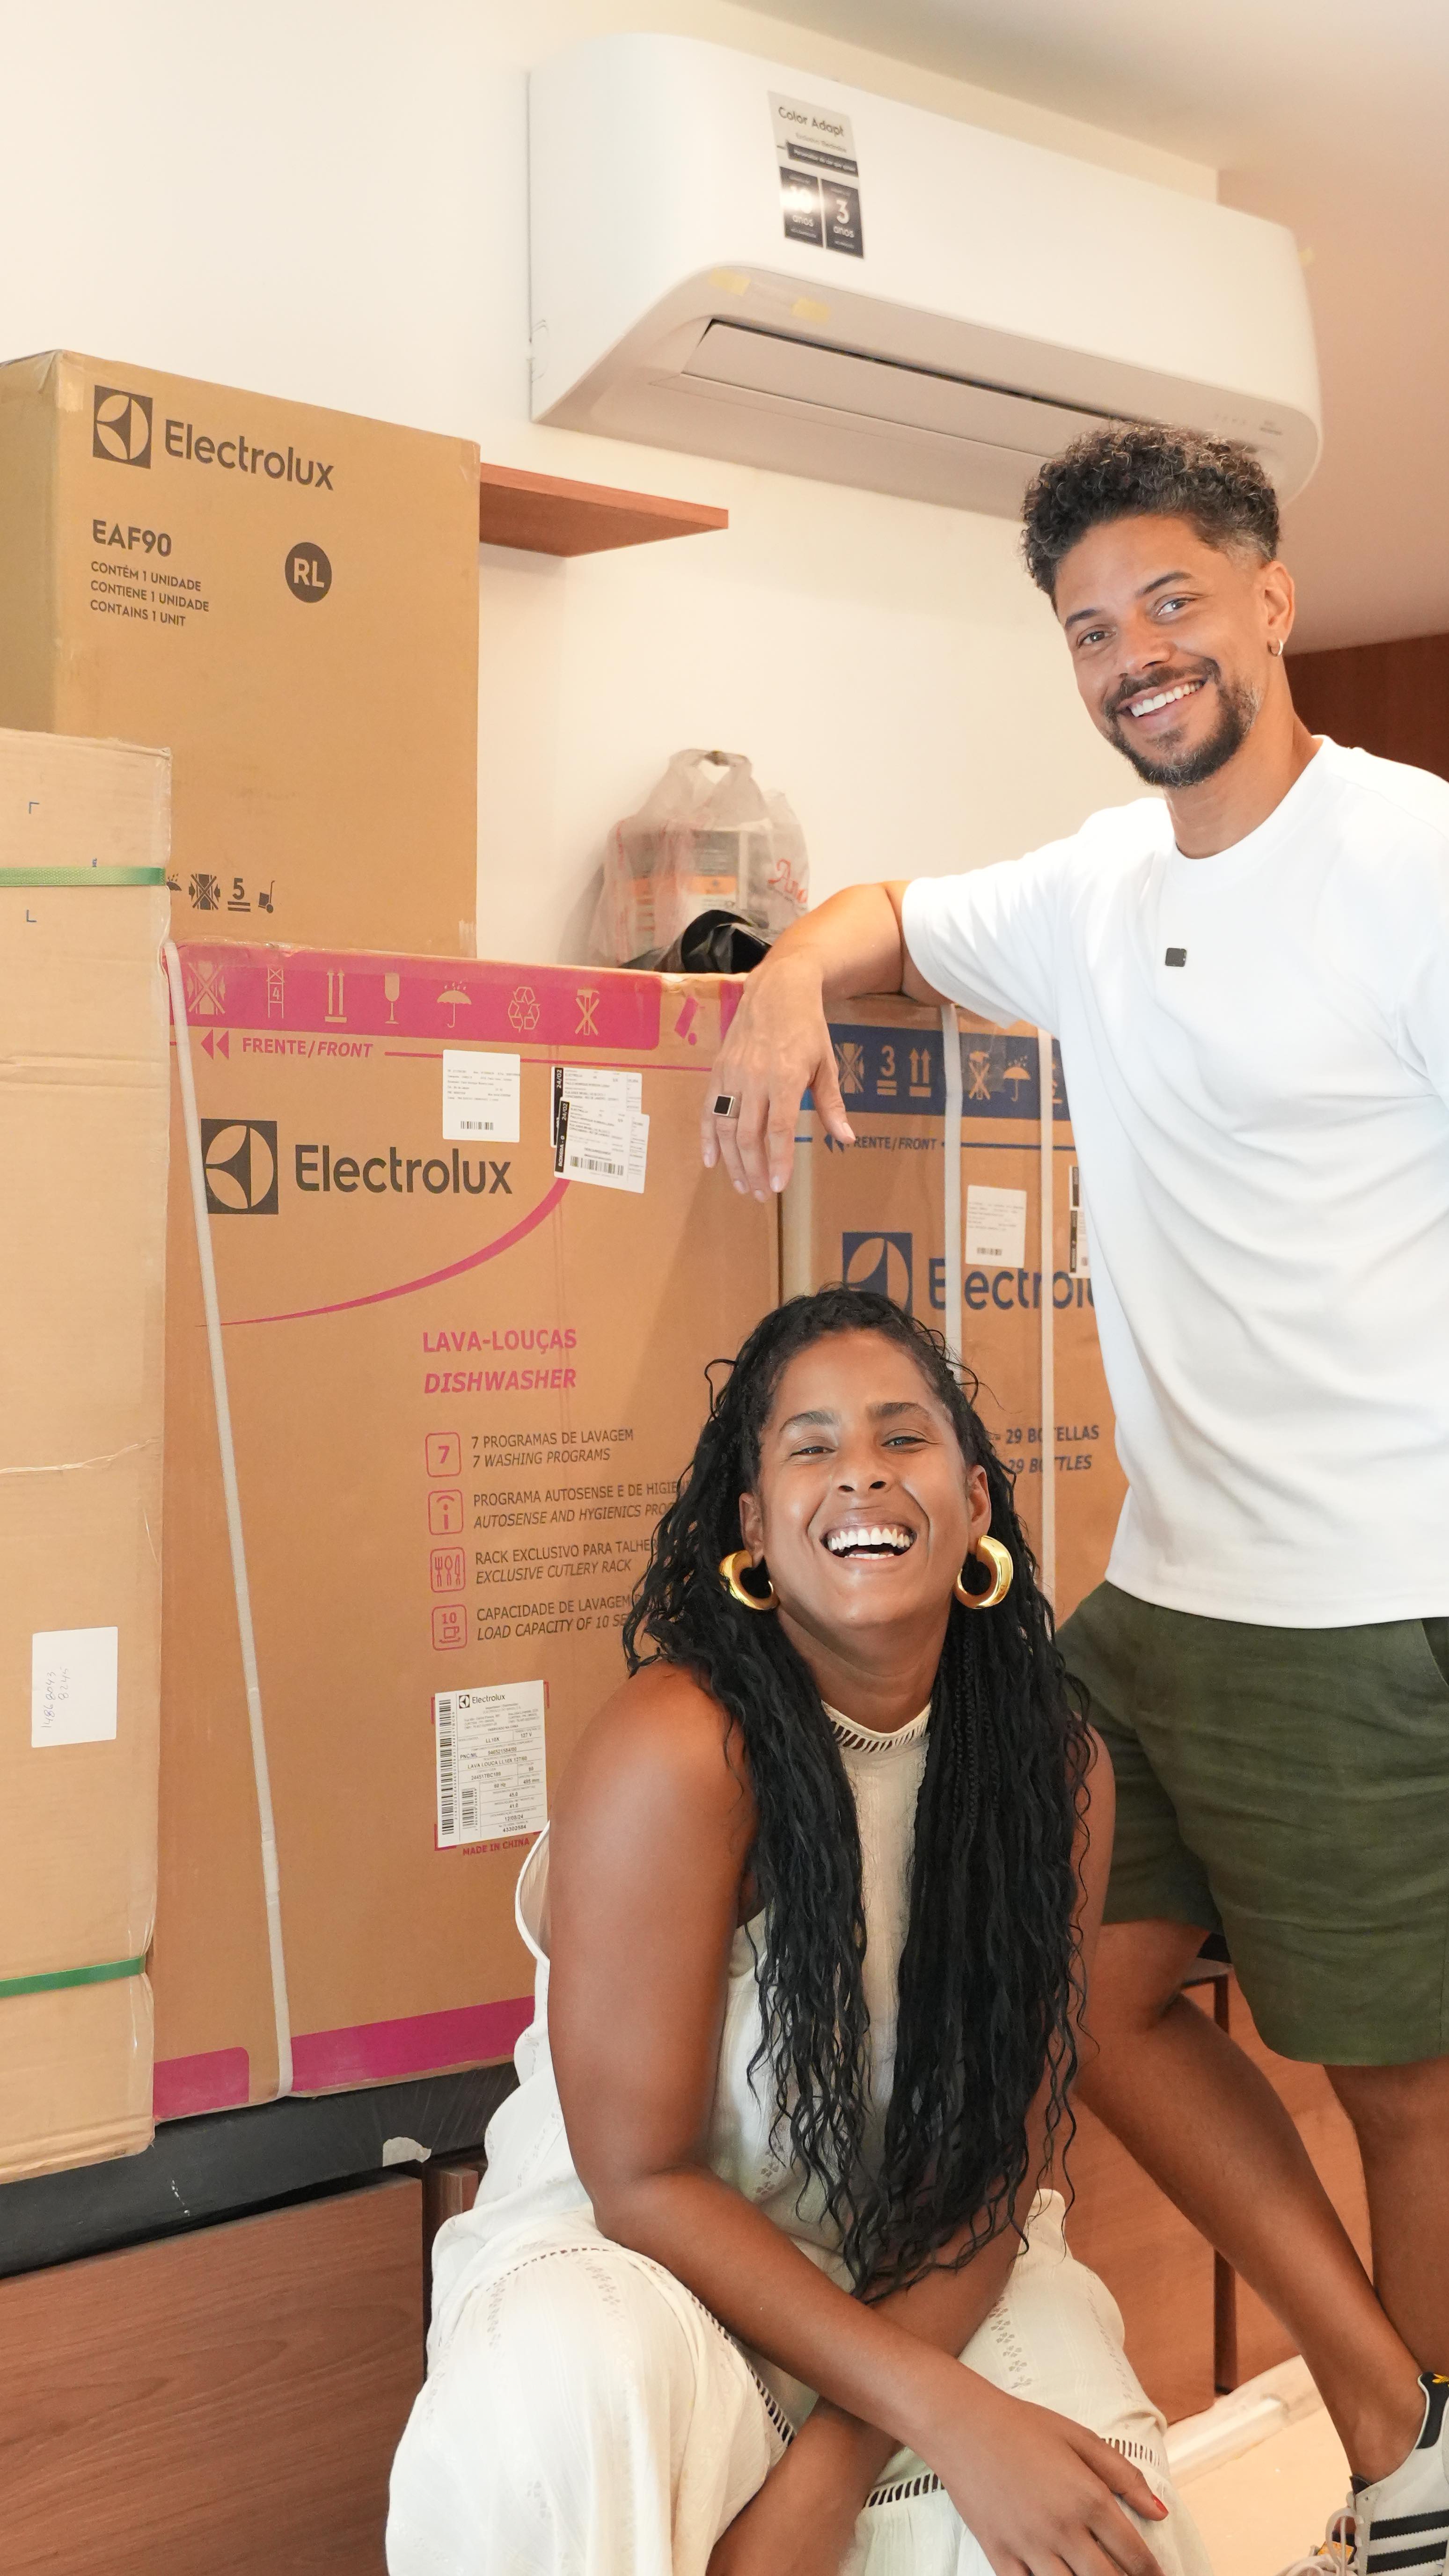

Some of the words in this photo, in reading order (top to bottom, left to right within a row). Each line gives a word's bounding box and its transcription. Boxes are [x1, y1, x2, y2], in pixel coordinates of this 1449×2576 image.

[778, 106, 808, 125] Color
[812, 118, 844, 137] Adapt
[793, 215, 814, 227] anos
[836, 199, 850, 224] 3
[833, 226, 855, 238] anos
[165, 419, 334, 491] Electrolux
[93, 520, 172, 557] EAF90
[91, 561, 139, 580] CONTÉM
[142, 571, 147, 582] 1
[151, 572, 201, 592] UNIDADE
[293, 557, 325, 588] RL
[90, 580, 147, 600] CONTIENE
[151, 591, 155, 602] 1
[159, 593, 210, 612] UNIDADE
[90, 600, 148, 620] CONTAINS
[152, 610, 156, 622] 1
[160, 612, 186, 626] UNIT
[232, 878, 245, 900] 5
[272, 987, 280, 1001] 4
[242, 1037, 374, 1058] FRENTE/FRONT
[881, 1045, 895, 1076] 3
[848, 1136, 937, 1152] RENTE/FRONT
[295, 1144, 512, 1194] Electrolux
[423, 1328, 577, 1354] LAVA-LOUÇAS
[424, 1368, 577, 1393] DISHWASHER
[471, 1436, 479, 1449] 7
[483, 1432, 557, 1449] PROGRAMAS
[562, 1431, 577, 1444] DE
[581, 1428, 634, 1443] LAVAGEM
[1006, 1427, 1022, 1444] 29
[1028, 1425, 1099, 1443] BELLAS
[438, 1445, 450, 1464] 7
[473, 1455, 480, 1468] 7
[484, 1452, 542, 1467] WASHING
[547, 1448, 611, 1464] PROGRAMS
[1029, 1455, 1092, 1473] BTLES
[474, 1490, 541, 1507] PROGRAMA
[545, 1486, 613, 1502] AUTOSENSE
[617, 1485, 624, 1497] E
[628, 1484, 642, 1496] DE
[474, 1512, 548, 1529] AUTOSENSE
[550, 1509, 574, 1523] AND
[579, 1504, 642, 1521] HYGIENICS
[476, 1550, 509, 1565] RACK
[513, 1544, 579, 1561] EXCLUSIVO
[583, 1542, 612, 1557] PARA
[476, 1566, 543, 1584] EXCLUSIVE
[547, 1561, 599, 1578] CUTLERY
[601, 1559, 632, 1573] RACK
[442, 1612, 457, 1625] 10
[477, 1602, 555, 1621] CAPACIDADE
[559, 1601, 574, 1613] DE
[578, 1595, 631, 1612] LAVAGEM
[477, 1625, 511, 1641] LOAD
[515, 1619, 574, 1637] CAPACITY
[576, 1617, 591, 1630] OF
[596, 1615, 608, 1629] 10
[472, 1694, 505, 1704] Electrolux
[463, 1845, 488, 1856] MADE
[503, 1838, 529, 1849] CHINA
